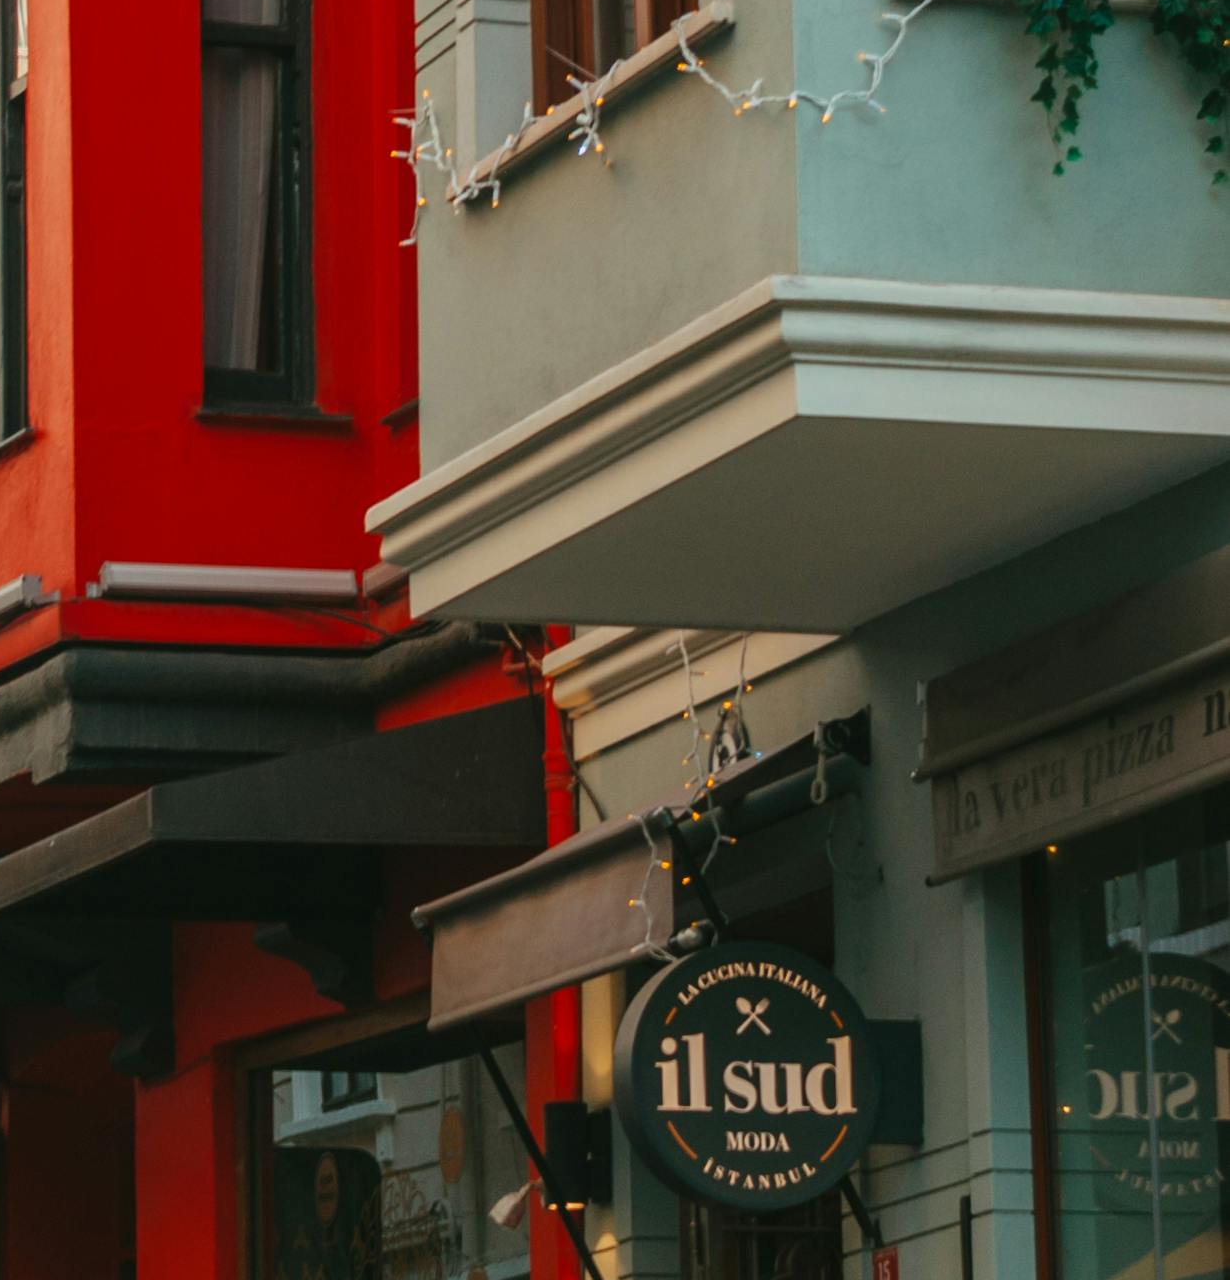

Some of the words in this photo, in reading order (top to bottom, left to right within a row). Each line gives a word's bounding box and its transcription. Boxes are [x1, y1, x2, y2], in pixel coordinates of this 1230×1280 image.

[992, 758, 1067, 822] vera
[1082, 715, 1175, 808] pizza
[676, 984, 699, 1006] LA
[698, 962, 755, 989] CUCINA
[758, 962, 829, 1008] ITALIANA
[654, 1032, 713, 1112] il
[723, 1035, 858, 1115] sud
[726, 1131, 790, 1152] MODA
